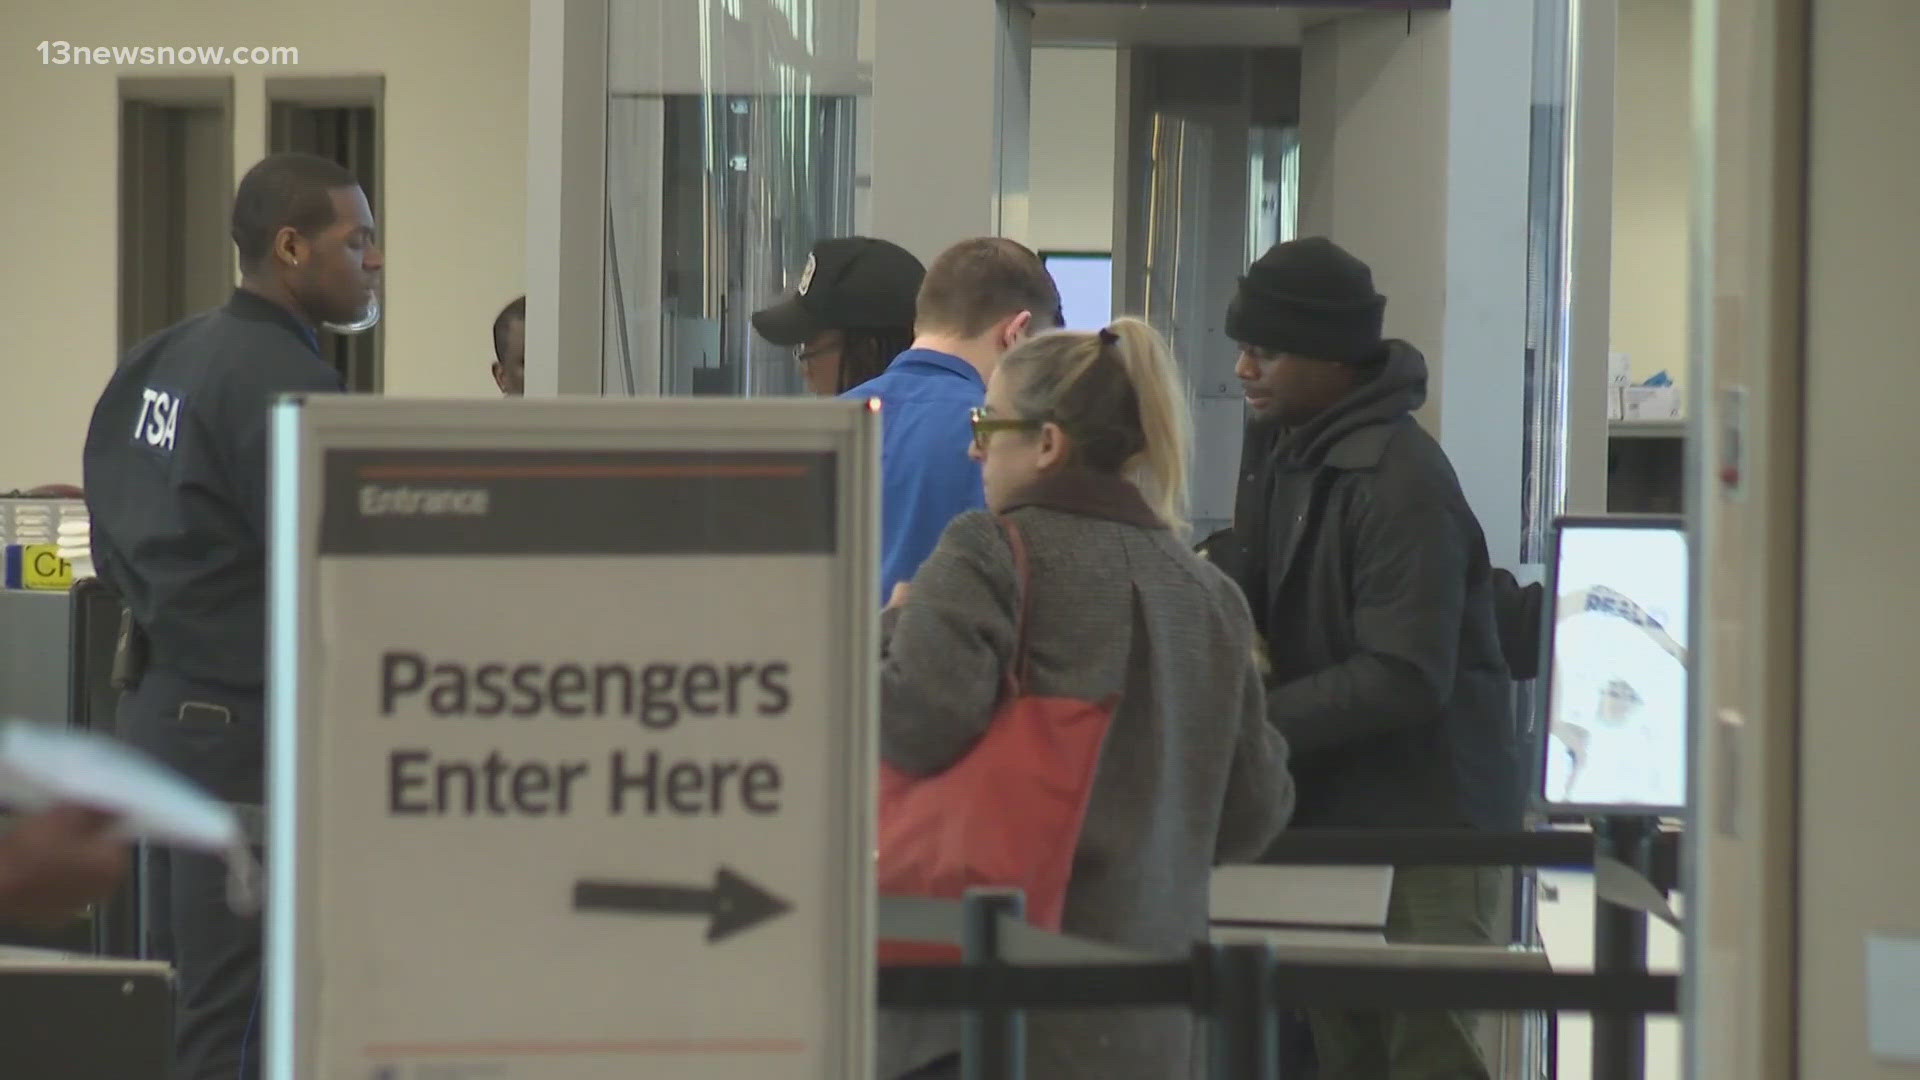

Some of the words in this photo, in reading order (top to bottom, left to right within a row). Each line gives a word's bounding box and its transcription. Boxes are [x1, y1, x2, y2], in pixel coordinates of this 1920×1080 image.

[135, 388, 181, 451] TSA
[359, 486, 489, 515] Entrance
[380, 650, 792, 730] Passengers
[388, 748, 590, 816] Enter
[607, 748, 782, 816] Here
